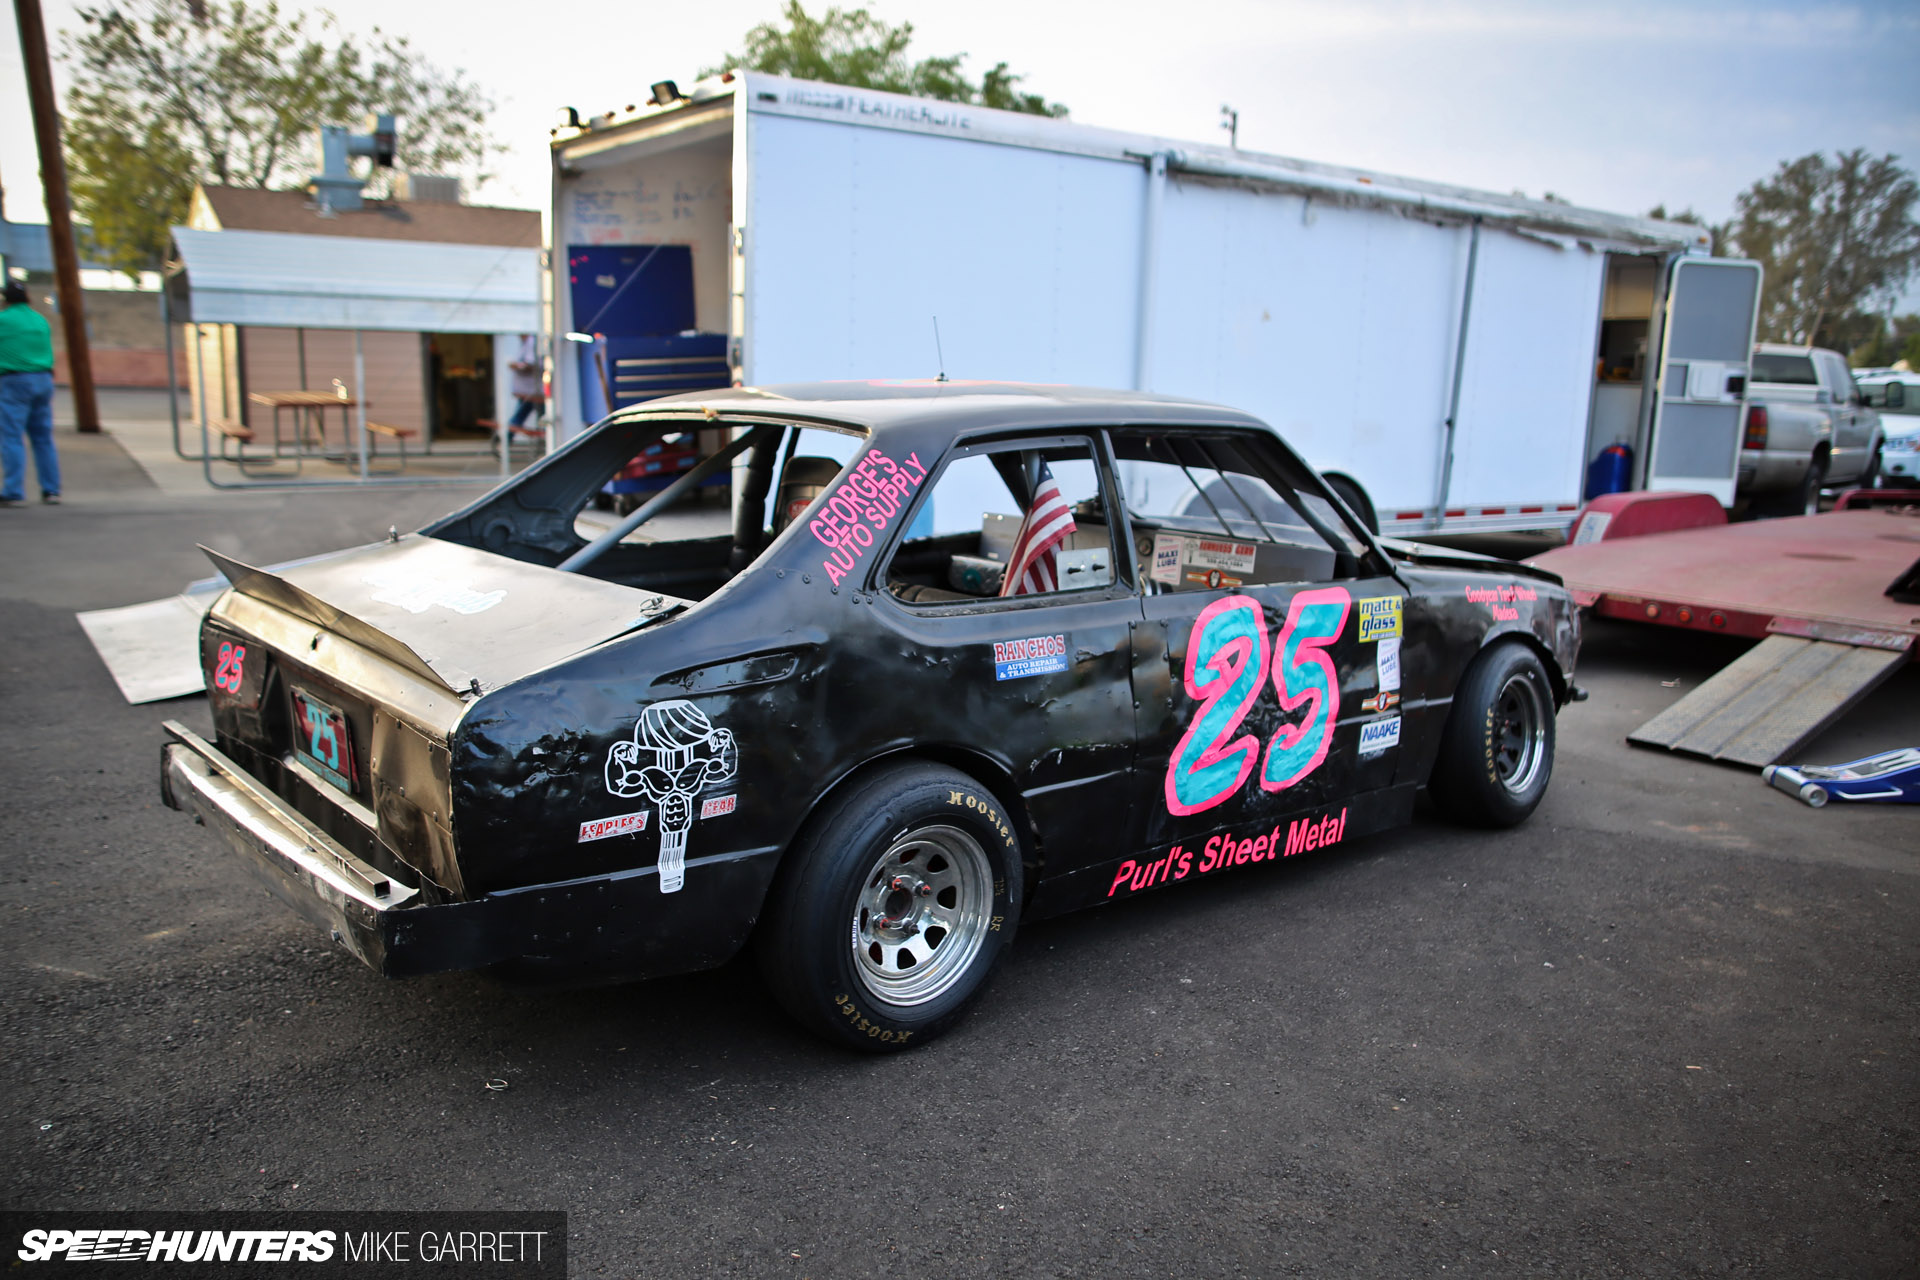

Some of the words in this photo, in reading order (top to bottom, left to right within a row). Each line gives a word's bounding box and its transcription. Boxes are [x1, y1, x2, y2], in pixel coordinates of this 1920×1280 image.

[809, 449, 898, 548] GEORGE'S
[823, 523, 874, 587] AUTO
[865, 452, 928, 530] SUPPLY
[1157, 550, 1178, 559] MAXI
[1157, 558, 1177, 568] LUBE
[1361, 599, 1393, 616] matt
[1361, 616, 1397, 639] glass
[994, 634, 1066, 663] RANCHOS
[1381, 652, 1397, 666] MAXI
[215, 641, 246, 694] 25
[1000, 671, 1007, 679] &
[1007, 663, 1066, 678] TRANSMISSION
[1007, 662, 1029, 671] AUTO
[1029, 658, 1058, 668] REPAIR
[1381, 661, 1397, 676] LUBE
[1164, 586, 1352, 817] 25
[305, 703, 339, 770] 25
[1362, 721, 1400, 742] NAAKE
[946, 790, 1015, 848] Hoosier
[1108, 846, 1193, 897] Purl's
[1199, 825, 1281, 873] Sheet
[1287, 807, 1348, 855] Metal
